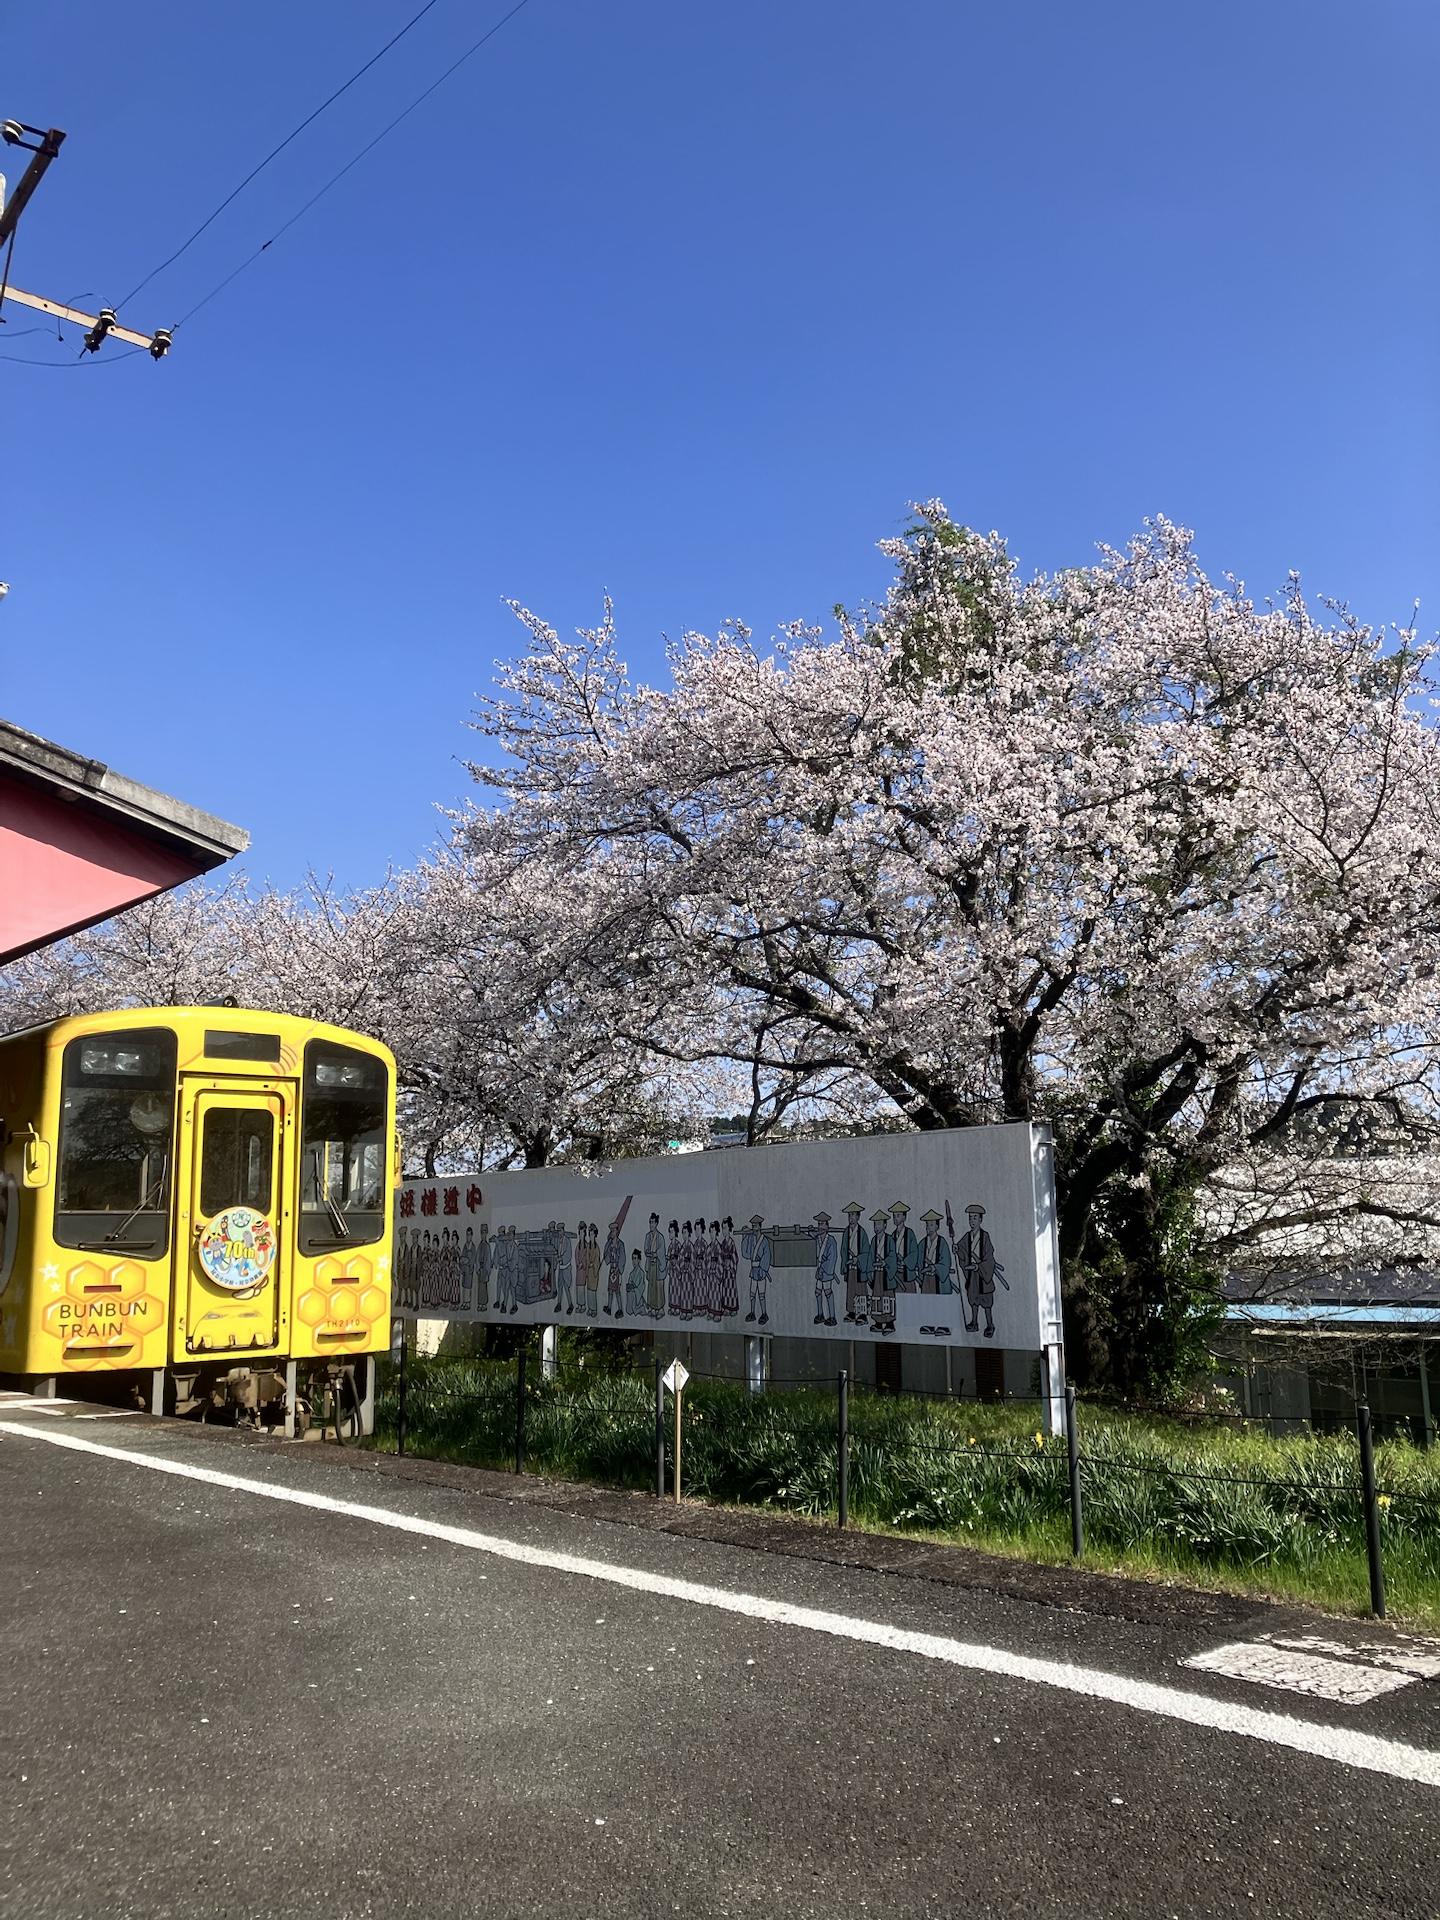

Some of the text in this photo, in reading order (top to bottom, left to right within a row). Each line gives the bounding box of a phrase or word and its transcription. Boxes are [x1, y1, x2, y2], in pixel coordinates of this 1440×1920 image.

[223, 1240, 256, 1259] 70th
[59, 1302, 147, 1319] BUNBUN
[853, 1295, 896, 1316] 細江町
[58, 1322, 123, 1338] TRAIN
